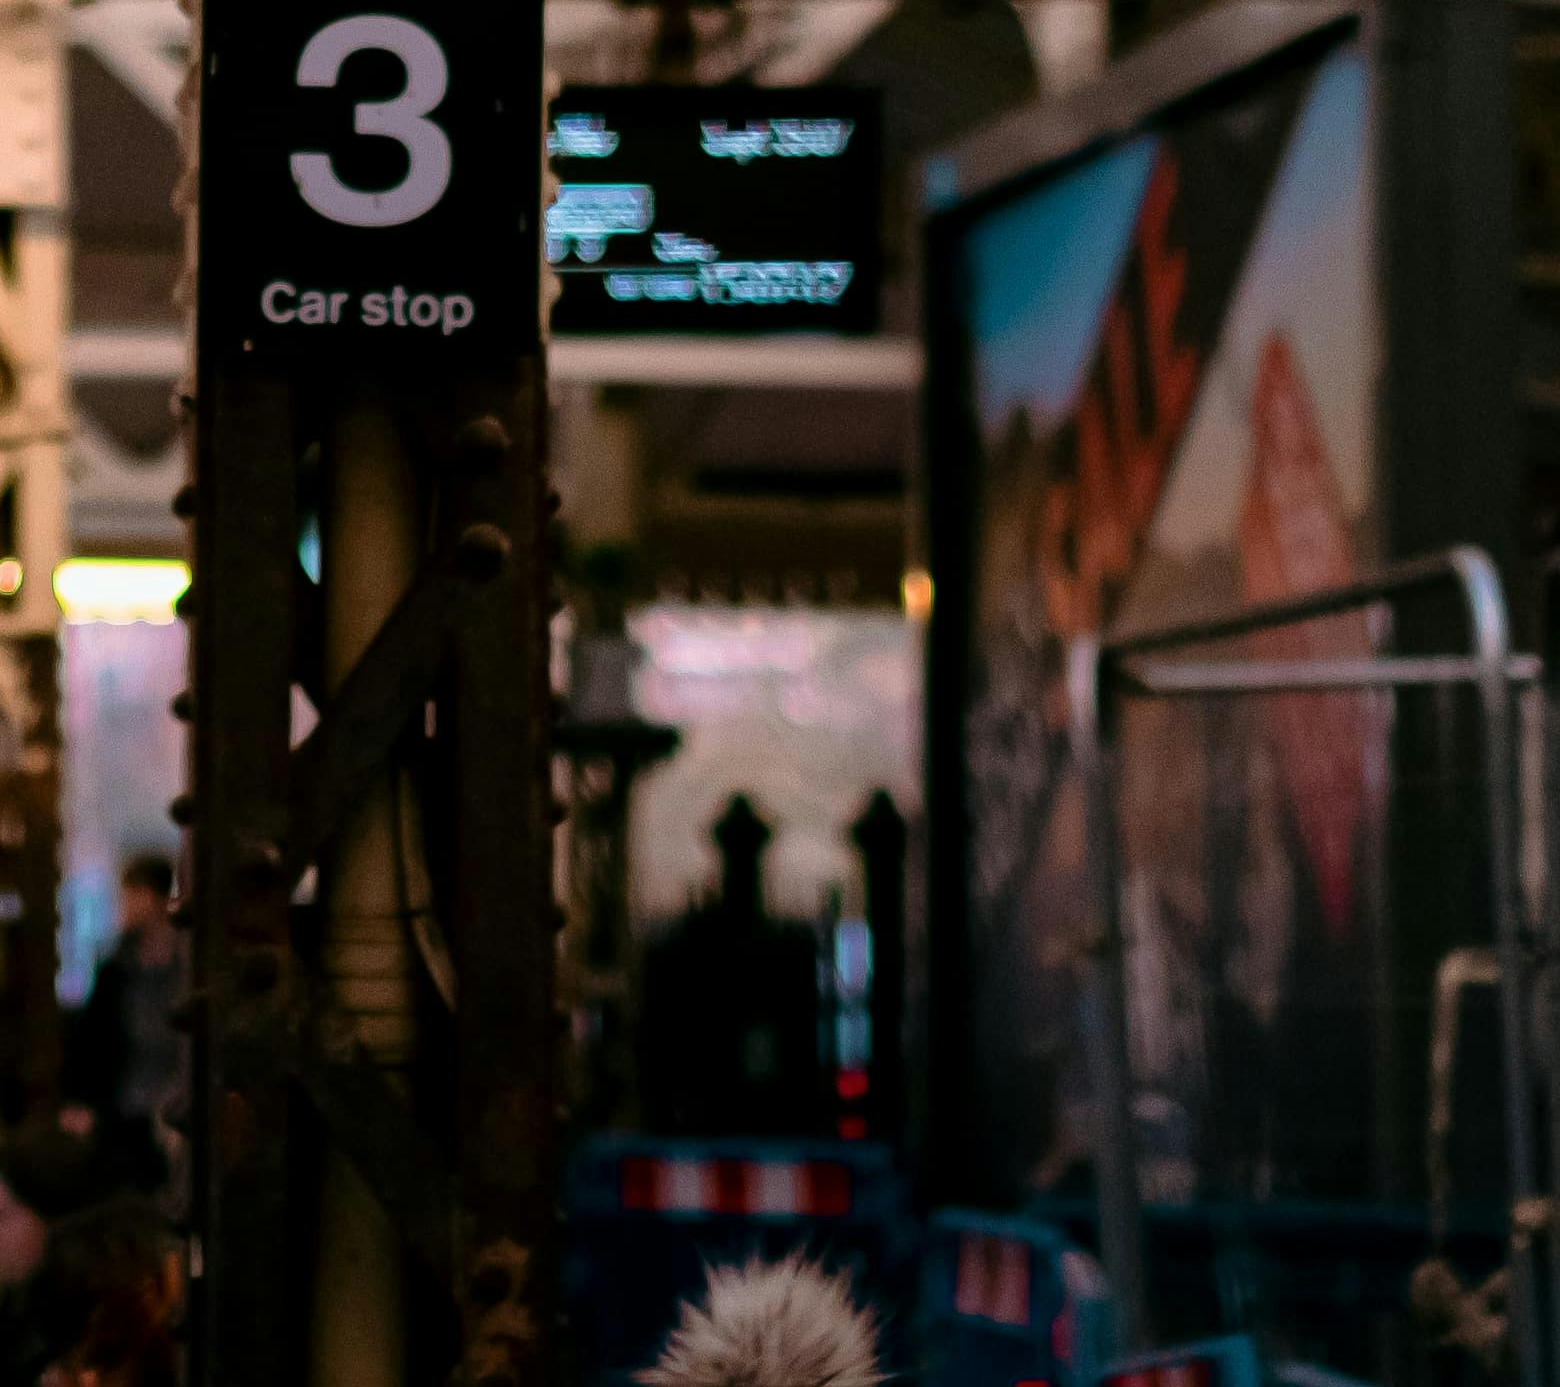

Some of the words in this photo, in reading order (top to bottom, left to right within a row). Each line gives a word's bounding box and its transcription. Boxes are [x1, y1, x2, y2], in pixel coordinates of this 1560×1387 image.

[289, 14, 452, 228] 3
[261, 281, 349, 324] Car
[360, 284, 474, 336] stop
